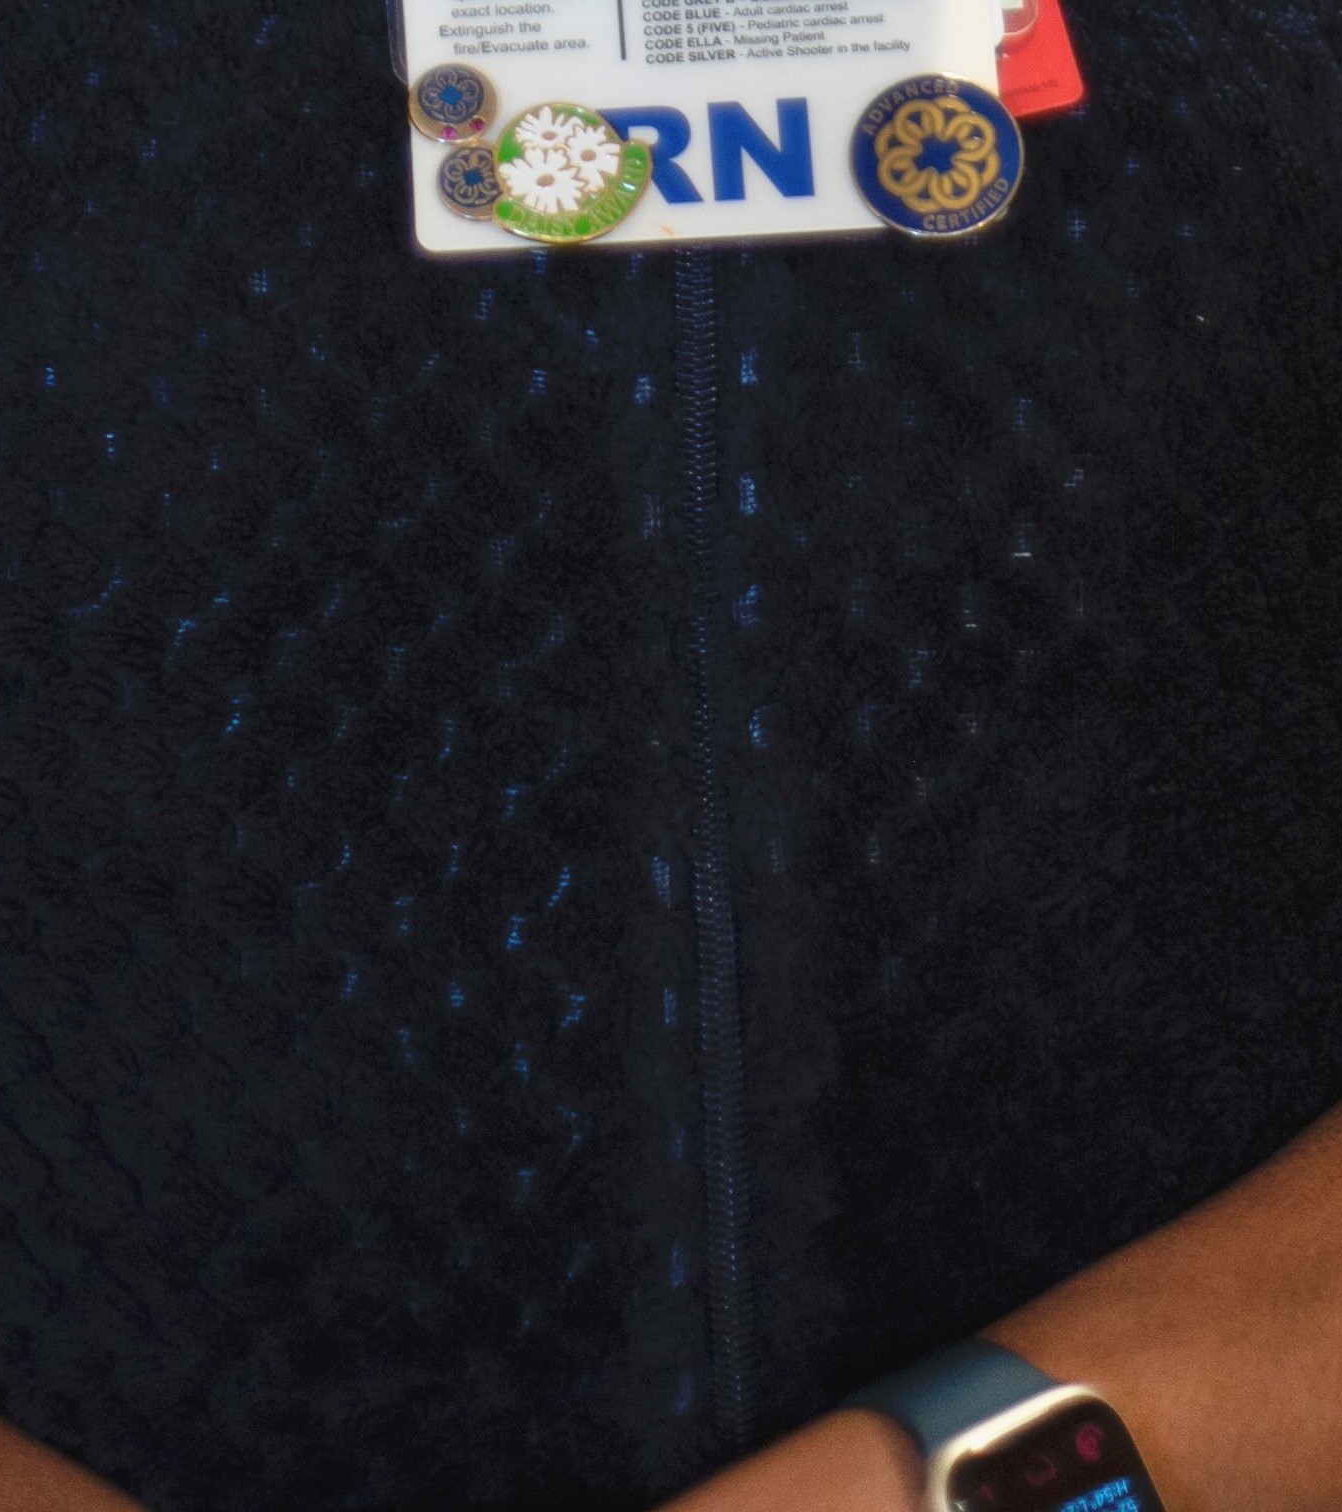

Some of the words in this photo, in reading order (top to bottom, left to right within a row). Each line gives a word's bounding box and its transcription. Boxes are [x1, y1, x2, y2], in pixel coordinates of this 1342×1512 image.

[451, 5, 491, 18] exact
[495, 2, 555, 16] location.
[643, 10, 681, 23] CODE
[685, 8, 721, 21] BLUE
[733, 4, 764, 18] Adult
[767, 2, 810, 15] cardiac
[814, 1, 848, 13] arrest
[439, 21, 513, 39] Extinguish
[518, 21, 541, 34] the
[644, 24, 682, 37] CODE
[697, 20, 736, 35] (FIVE)
[748, 17, 799, 32] Pediatric
[803, 15, 846, 28] cardiac
[850, 13, 884, 25] arrest
[453, 38, 549, 55] fire/Evacuate
[553, 37, 590, 50] area.
[644, 38, 683, 51] CODE
[687, 36, 722, 49] ELLA
[734, 32, 780, 47] Missing
[782, 30, 825, 43] Patient
[646, 52, 685, 65] CODE
[688, 49, 736, 63] SILVER
[747, 44, 783, 59] Active
[786, 42, 833, 58] Shooter
[837, 43, 848, 54] in
[851, 41, 870, 54] the
[873, 39, 910, 55] facility
[861, 77, 960, 136] ADVANCED
[595, 97, 815, 204] RN
[922, 177, 1010, 232] CERTIFIED
